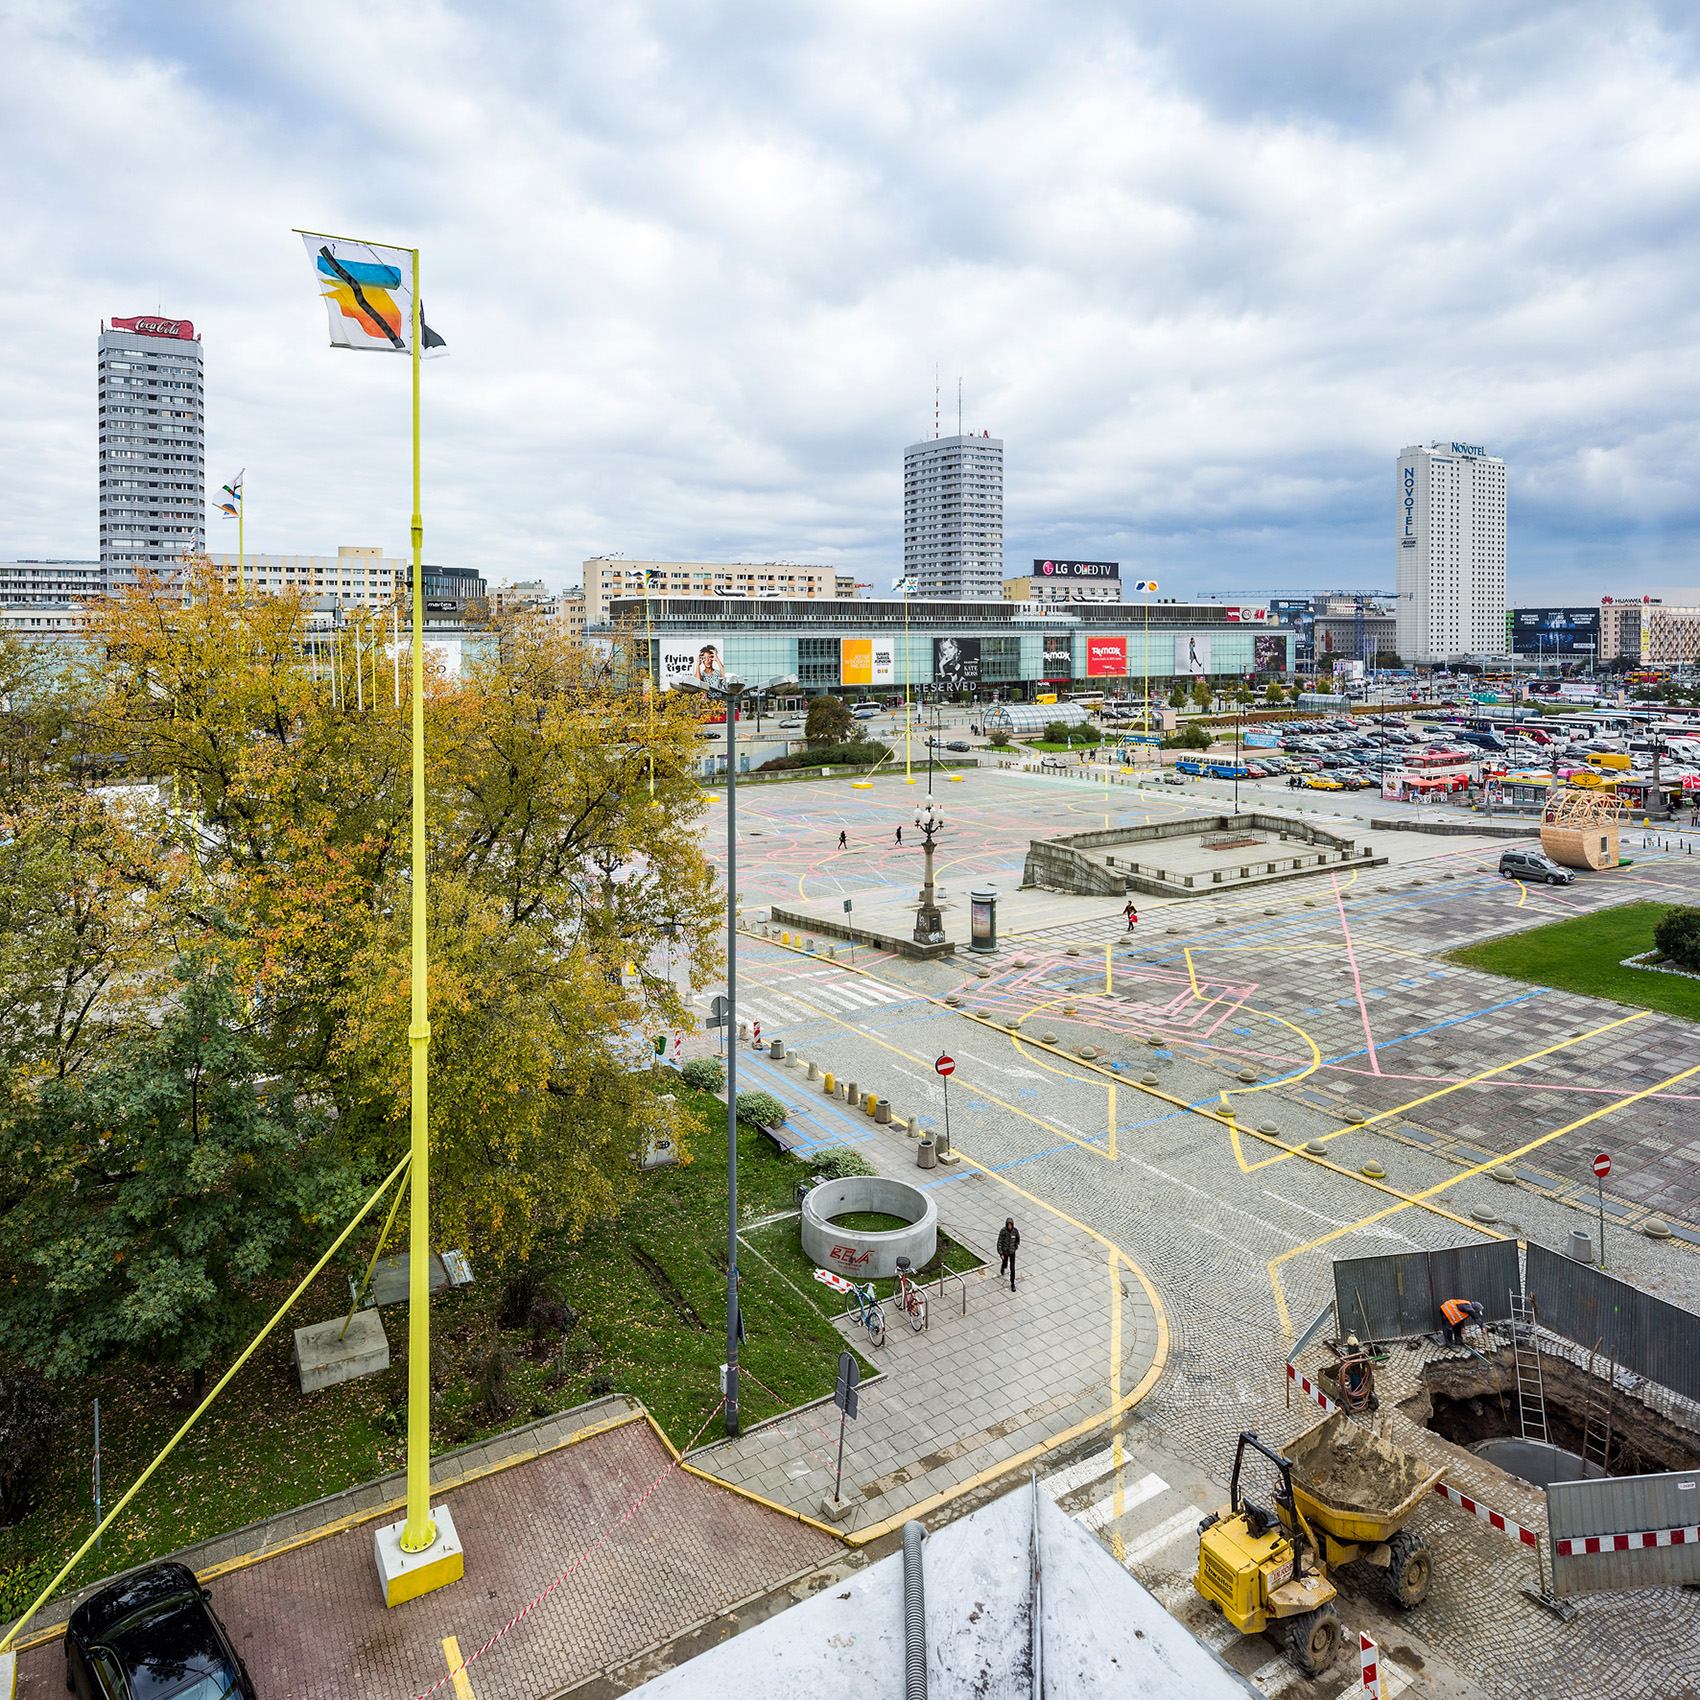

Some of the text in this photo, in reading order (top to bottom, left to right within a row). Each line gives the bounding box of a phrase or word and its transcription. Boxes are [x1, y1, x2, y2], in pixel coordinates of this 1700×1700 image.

[1451, 441, 1487, 457] NOVOTEL
[1404, 467, 1414, 536] NOVOTEL
[1055, 563, 1111, 575] LG OLED TV
[1254, 609, 1265, 620] H&M
[664, 654, 695, 664] flying
[666, 663, 693, 673] tiger
[914, 682, 977, 693] RESERVED
[1205, 1562, 1233, 1591] Thwaites
